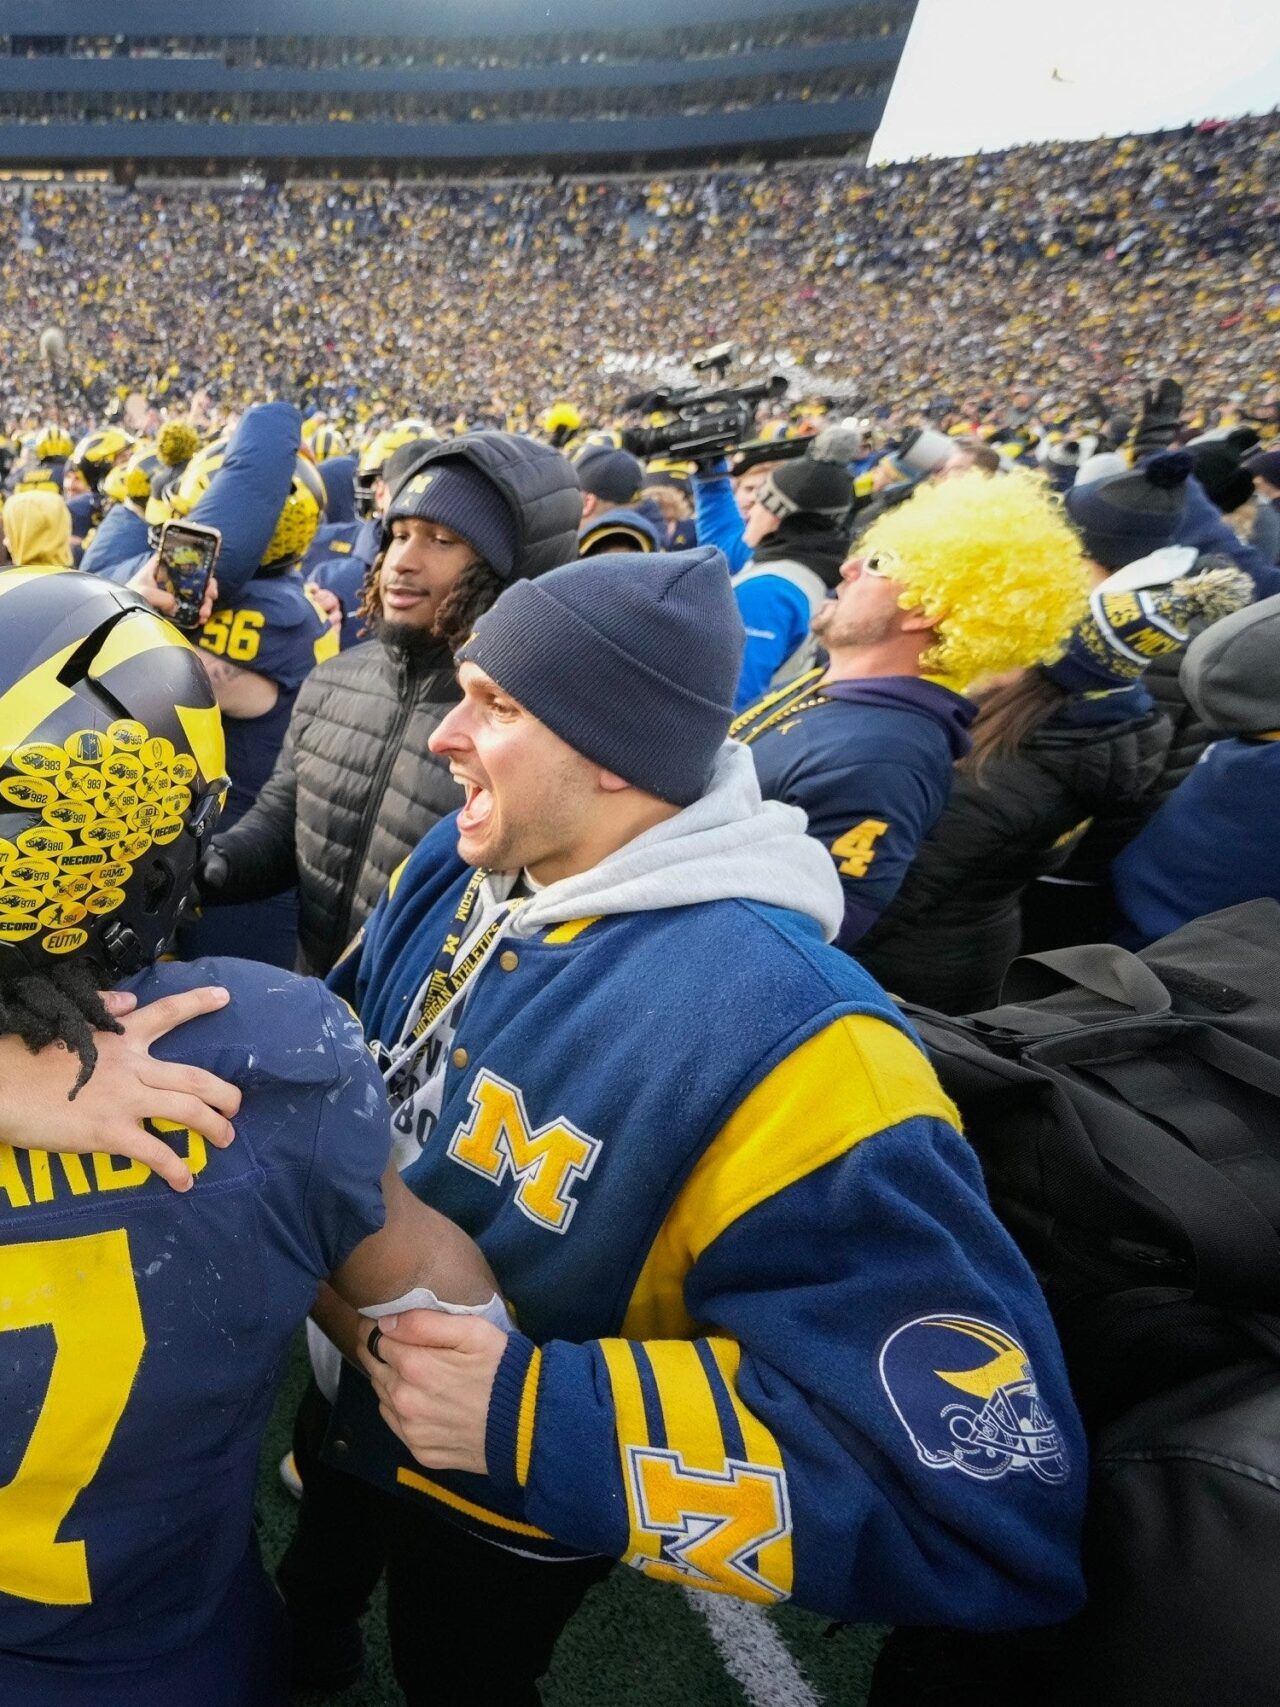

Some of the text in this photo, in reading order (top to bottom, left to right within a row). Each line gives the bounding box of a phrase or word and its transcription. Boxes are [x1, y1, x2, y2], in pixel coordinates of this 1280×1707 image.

[199, 609, 265, 661] 56
[44, 760, 61, 771] 983
[30, 793, 48, 804] 982
[47, 841, 64, 851] 980
[830, 818, 889, 877] 4
[61, 854, 104, 866] RECORD
[33, 871, 50, 882] 979
[99, 867, 127, 879] GAME
[47, 932, 82, 949] EUTM
[442, 933, 460, 956] M
[413, 985, 455, 1039] MICHIGAN
[450, 922, 503, 990] ATHLETICS
[446, 1066, 604, 1235] M
[624, 1444, 793, 1606] M
